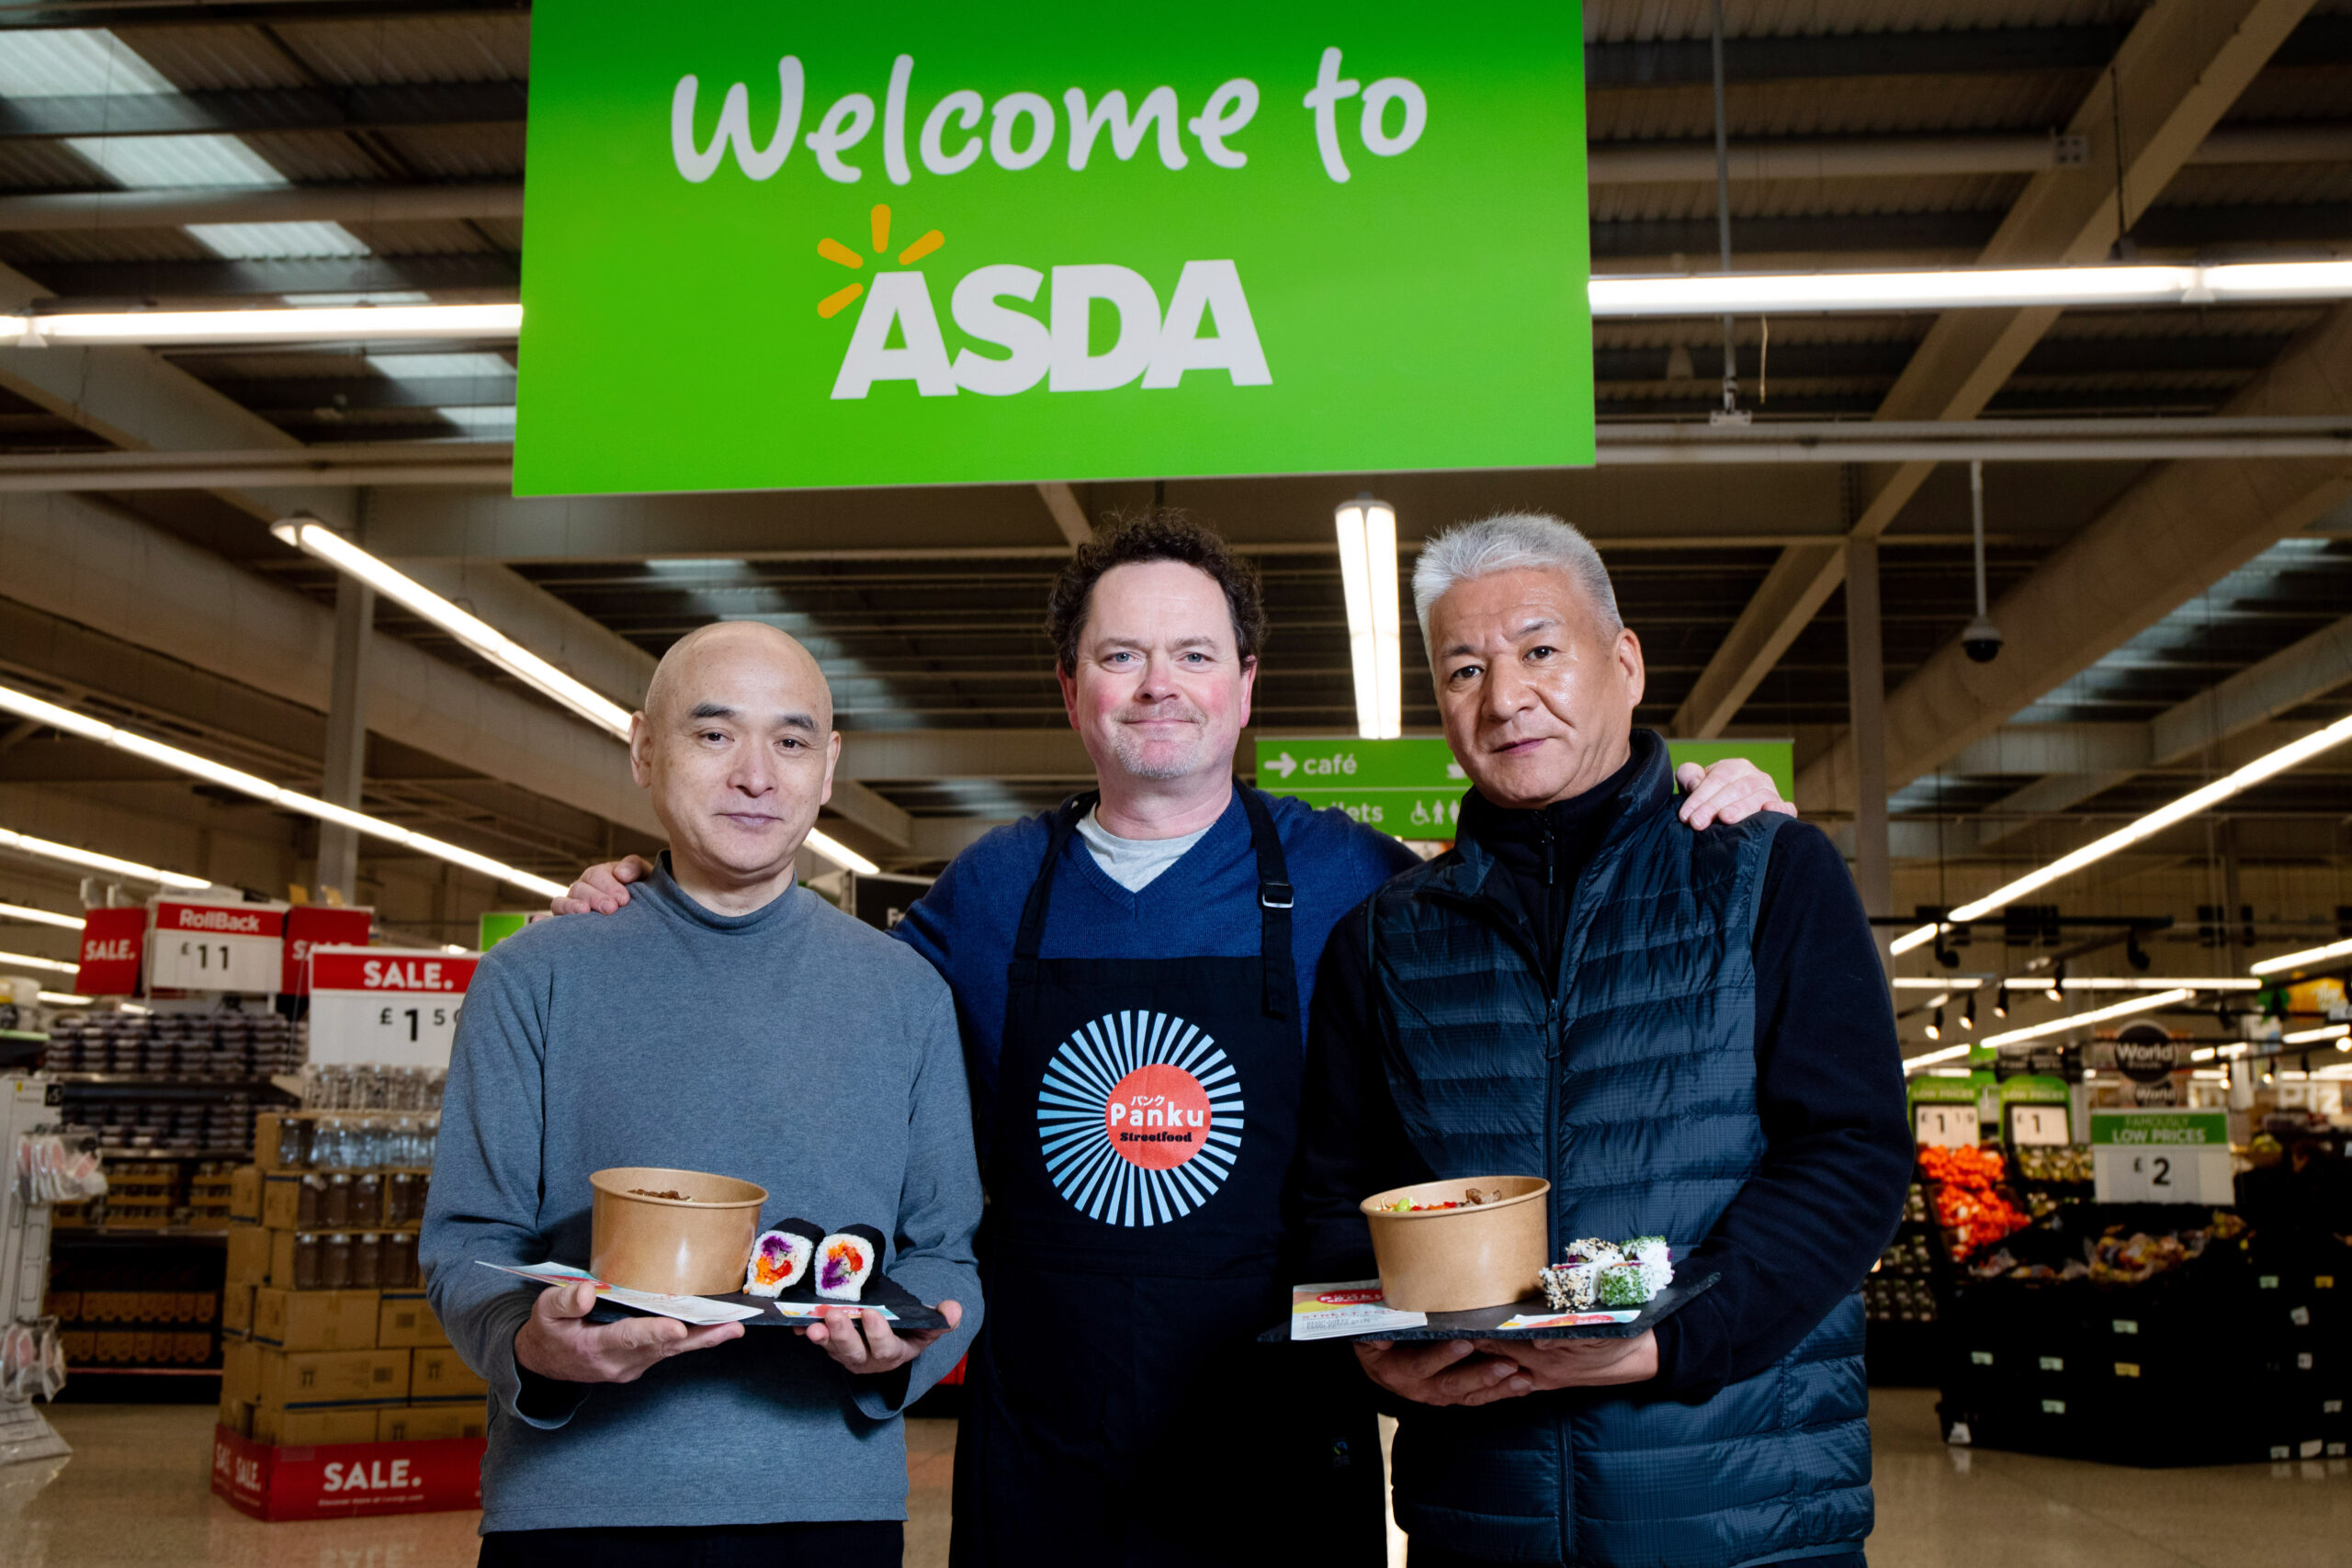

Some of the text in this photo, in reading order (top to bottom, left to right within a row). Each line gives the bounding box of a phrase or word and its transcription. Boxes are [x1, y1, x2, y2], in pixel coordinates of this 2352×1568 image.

[672, 46, 1428, 185] Welcome to
[830, 259, 1273, 400] ASDA
[1303, 752, 1357, 775] café
[179, 909, 259, 931] RollBack
[85, 939, 136, 961] SALE.
[363, 960, 454, 990] SALE.
[2116, 1043, 2173, 1061] World
[1110, 1101, 1204, 1127] Panku
[1120, 1132, 1192, 1143] Streetfood
[2112, 1129, 2205, 1144] LOW PRICES
[322, 1459, 422, 1493] SALE.
